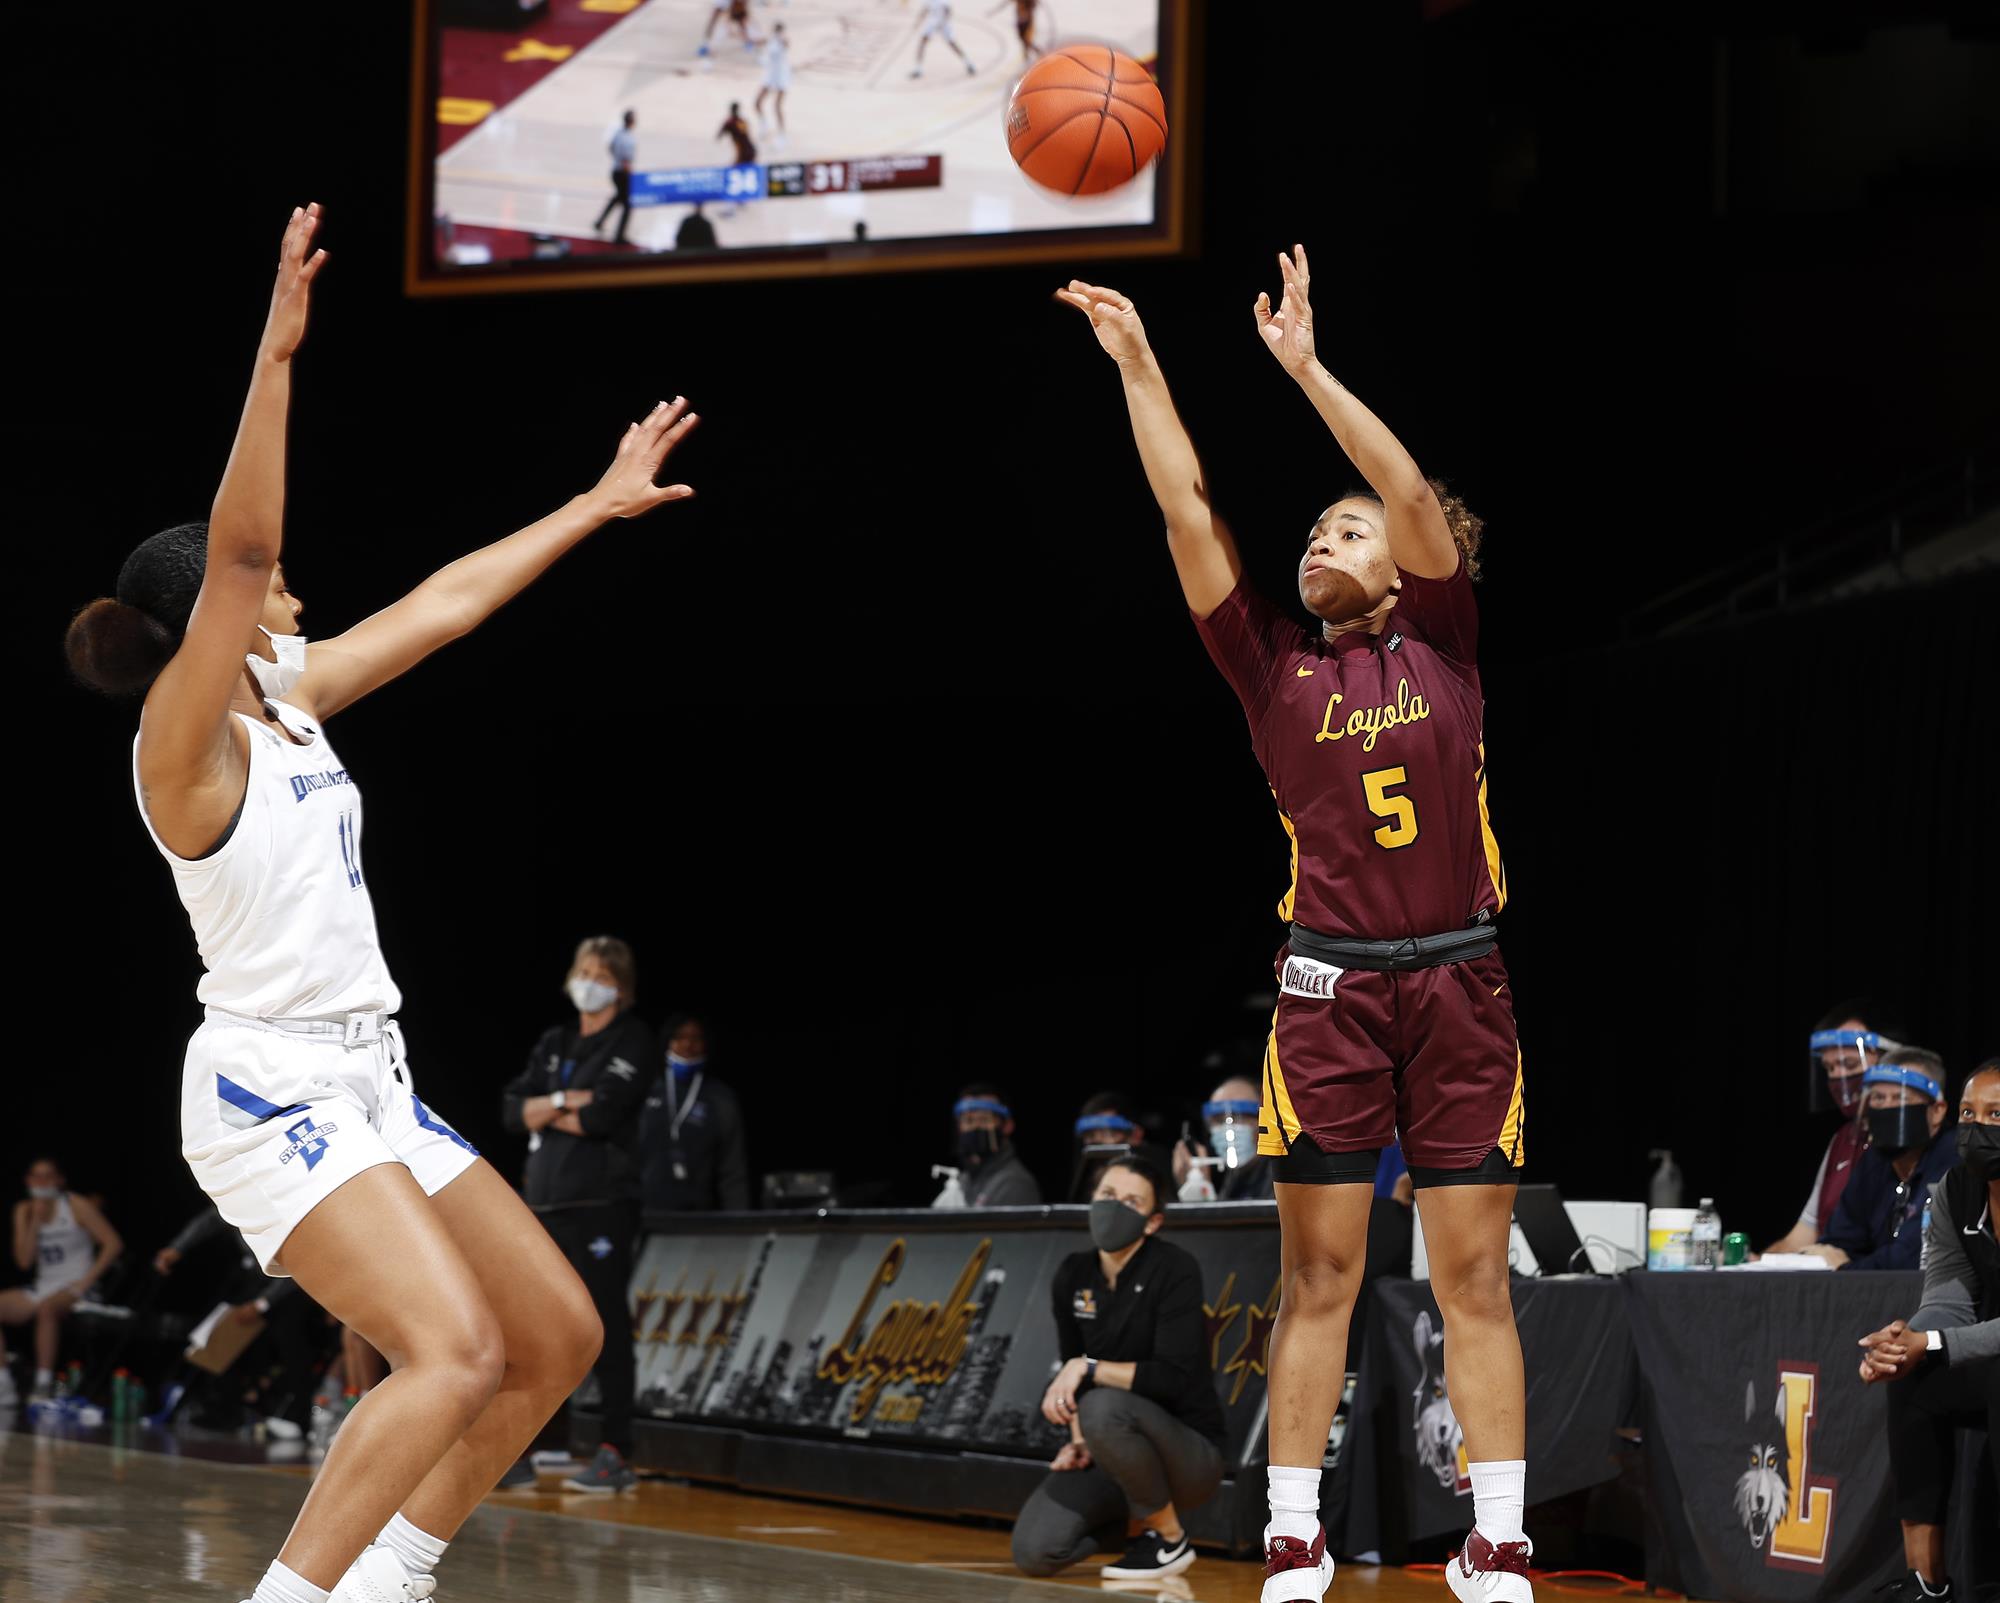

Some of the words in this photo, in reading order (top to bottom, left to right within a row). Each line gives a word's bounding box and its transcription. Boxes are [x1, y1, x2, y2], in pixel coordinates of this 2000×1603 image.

[810, 164, 845, 190] 31
[1387, 632, 1402, 651] ONE
[1315, 678, 1430, 752] Loyola
[1361, 765, 1419, 850] 5
[1285, 960, 1337, 996] VALLEY
[280, 1122, 337, 1164] SYCAMORES
[1767, 1362, 1839, 1573] L
